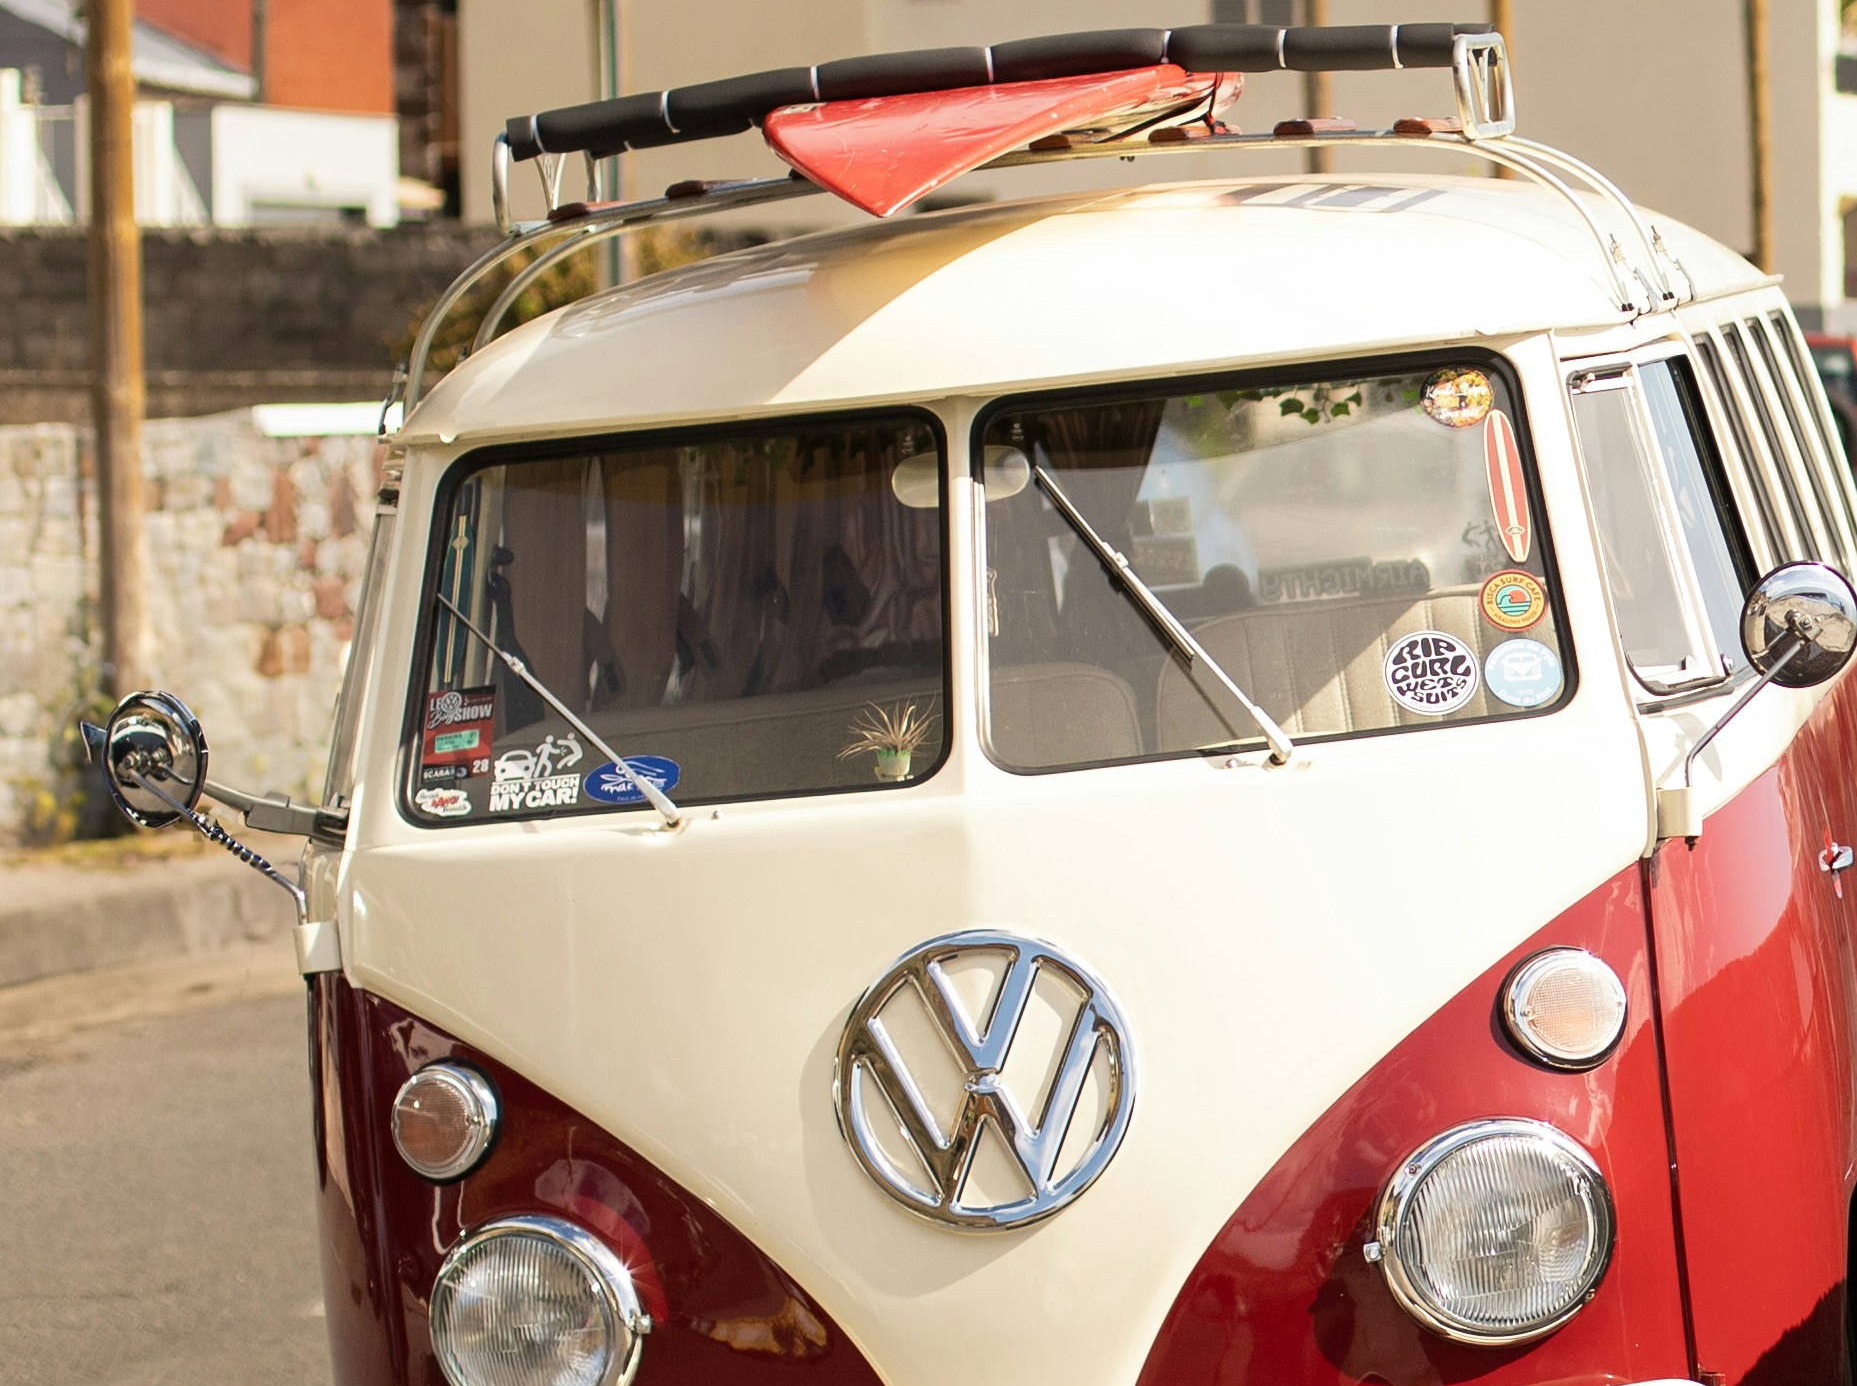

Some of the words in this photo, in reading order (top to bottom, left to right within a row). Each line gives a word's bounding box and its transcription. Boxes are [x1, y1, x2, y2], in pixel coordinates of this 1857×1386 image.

[1486, 583, 1502, 605] BISCA
[1500, 576, 1525, 586] SURF
[1494, 612, 1521, 624] HEALTHY
[1521, 611, 1538, 623] FOOD
[1392, 637, 1457, 665] RIP
[1391, 654, 1472, 685] CURL
[1396, 676, 1454, 697] WET
[1410, 677, 1467, 705] SUITS
[453, 703, 493, 722] SHOW
[472, 758, 490, 774] 28
[533, 776, 580, 792] TOUCH
[489, 792, 526, 812] MY
[525, 786, 580, 808] CAR!
